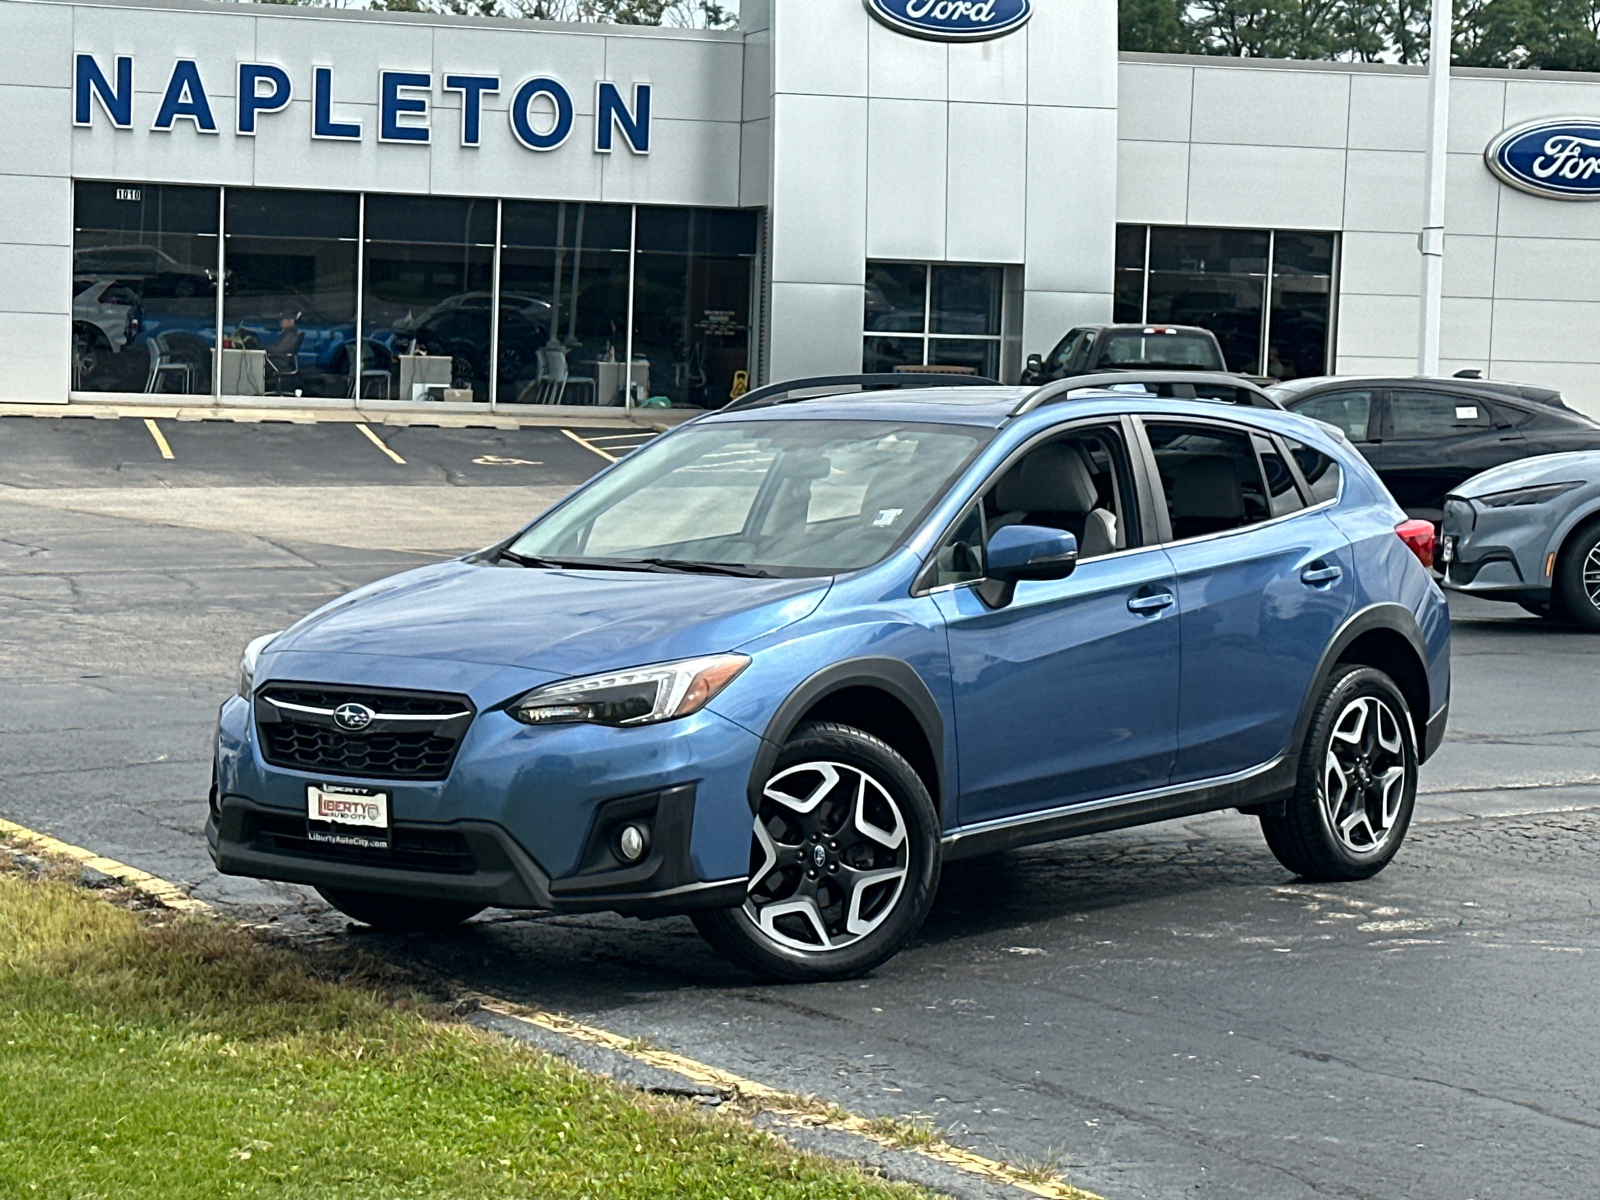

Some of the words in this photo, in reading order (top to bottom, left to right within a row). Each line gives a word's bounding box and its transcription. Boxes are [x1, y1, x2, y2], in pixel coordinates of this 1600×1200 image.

[73, 53, 652, 154] NAPLETON
[1532, 135, 1600, 180] For
[116, 188, 141, 201] 1010
[318, 793, 368, 816] LIBERTY
[308, 832, 388, 849] LibertyAutoCity.com
